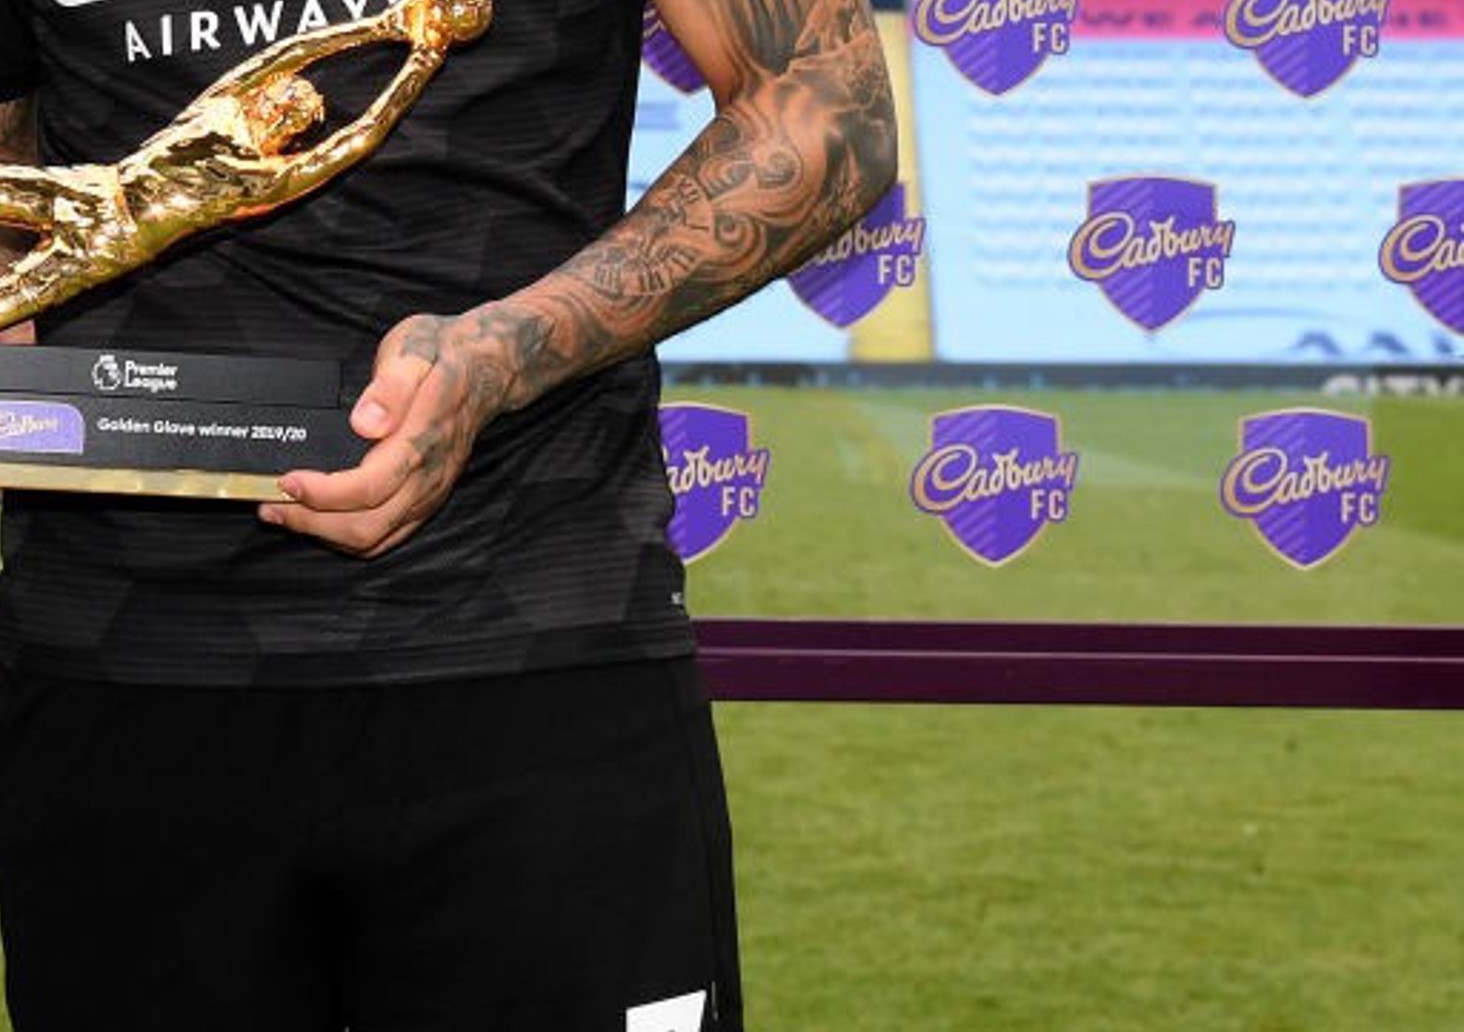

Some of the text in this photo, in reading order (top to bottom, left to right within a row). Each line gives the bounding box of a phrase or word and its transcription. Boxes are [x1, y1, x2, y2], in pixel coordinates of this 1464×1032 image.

[1032, 22, 1066, 53] FC
[1342, 24, 1376, 55] FC
[1071, 212, 1232, 279] Cadbury
[878, 255, 912, 286] FC
[1187, 257, 1221, 288] FC
[124, 360, 178, 375] Premier
[124, 373, 178, 392] League
[97, 418, 150, 433] Golden
[198, 424, 249, 438] winner
[663, 446, 767, 495] adbury
[914, 444, 1075, 511] Cadbury
[1224, 447, 1385, 514] Cadbury
[722, 486, 756, 517] FC
[1030, 489, 1064, 520] FC
[1340, 492, 1374, 523] FC
